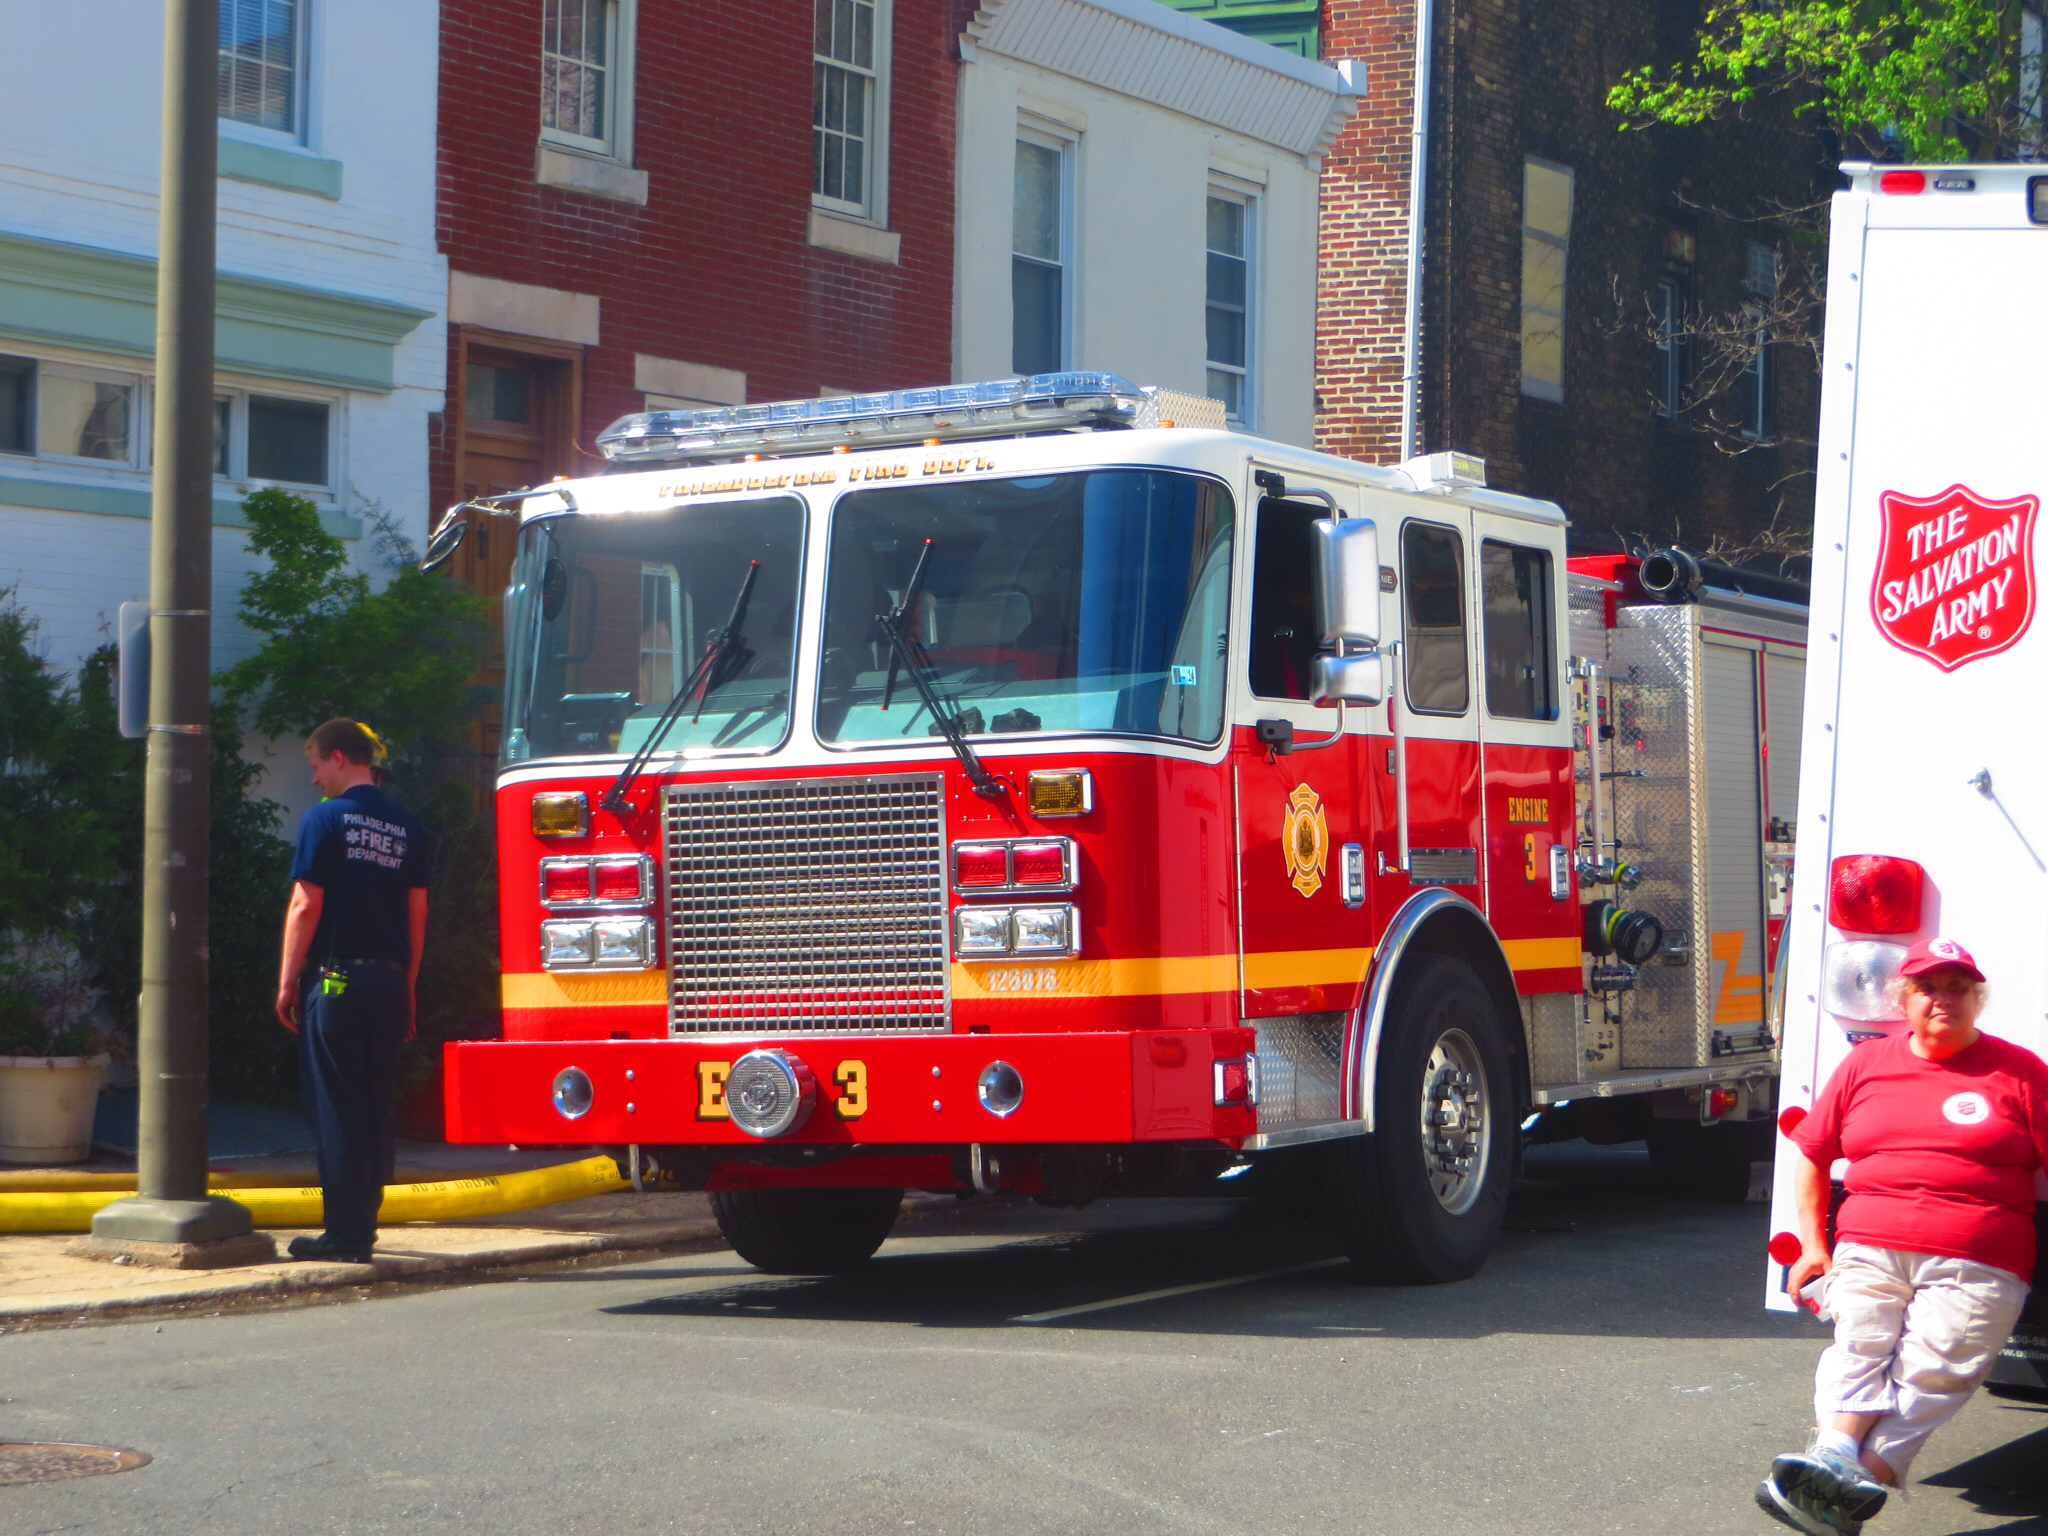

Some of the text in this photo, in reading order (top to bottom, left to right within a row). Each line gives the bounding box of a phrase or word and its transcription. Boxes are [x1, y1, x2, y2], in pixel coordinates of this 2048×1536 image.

[1906, 505, 1968, 562] THE
[1379, 574, 1393, 584] ME
[1881, 514, 2019, 623] SALVATION
[1926, 567, 2013, 648] ARMY
[1508, 797, 1549, 825] ENGINE
[343, 813, 407, 838] PHILADELPHIA
[361, 828, 393, 854] FIRE
[347, 847, 403, 869] DEPARTMENT
[1523, 832, 1537, 885] 3
[987, 967, 1058, 992] 126076
[695, 1059, 869, 1122] E 3
